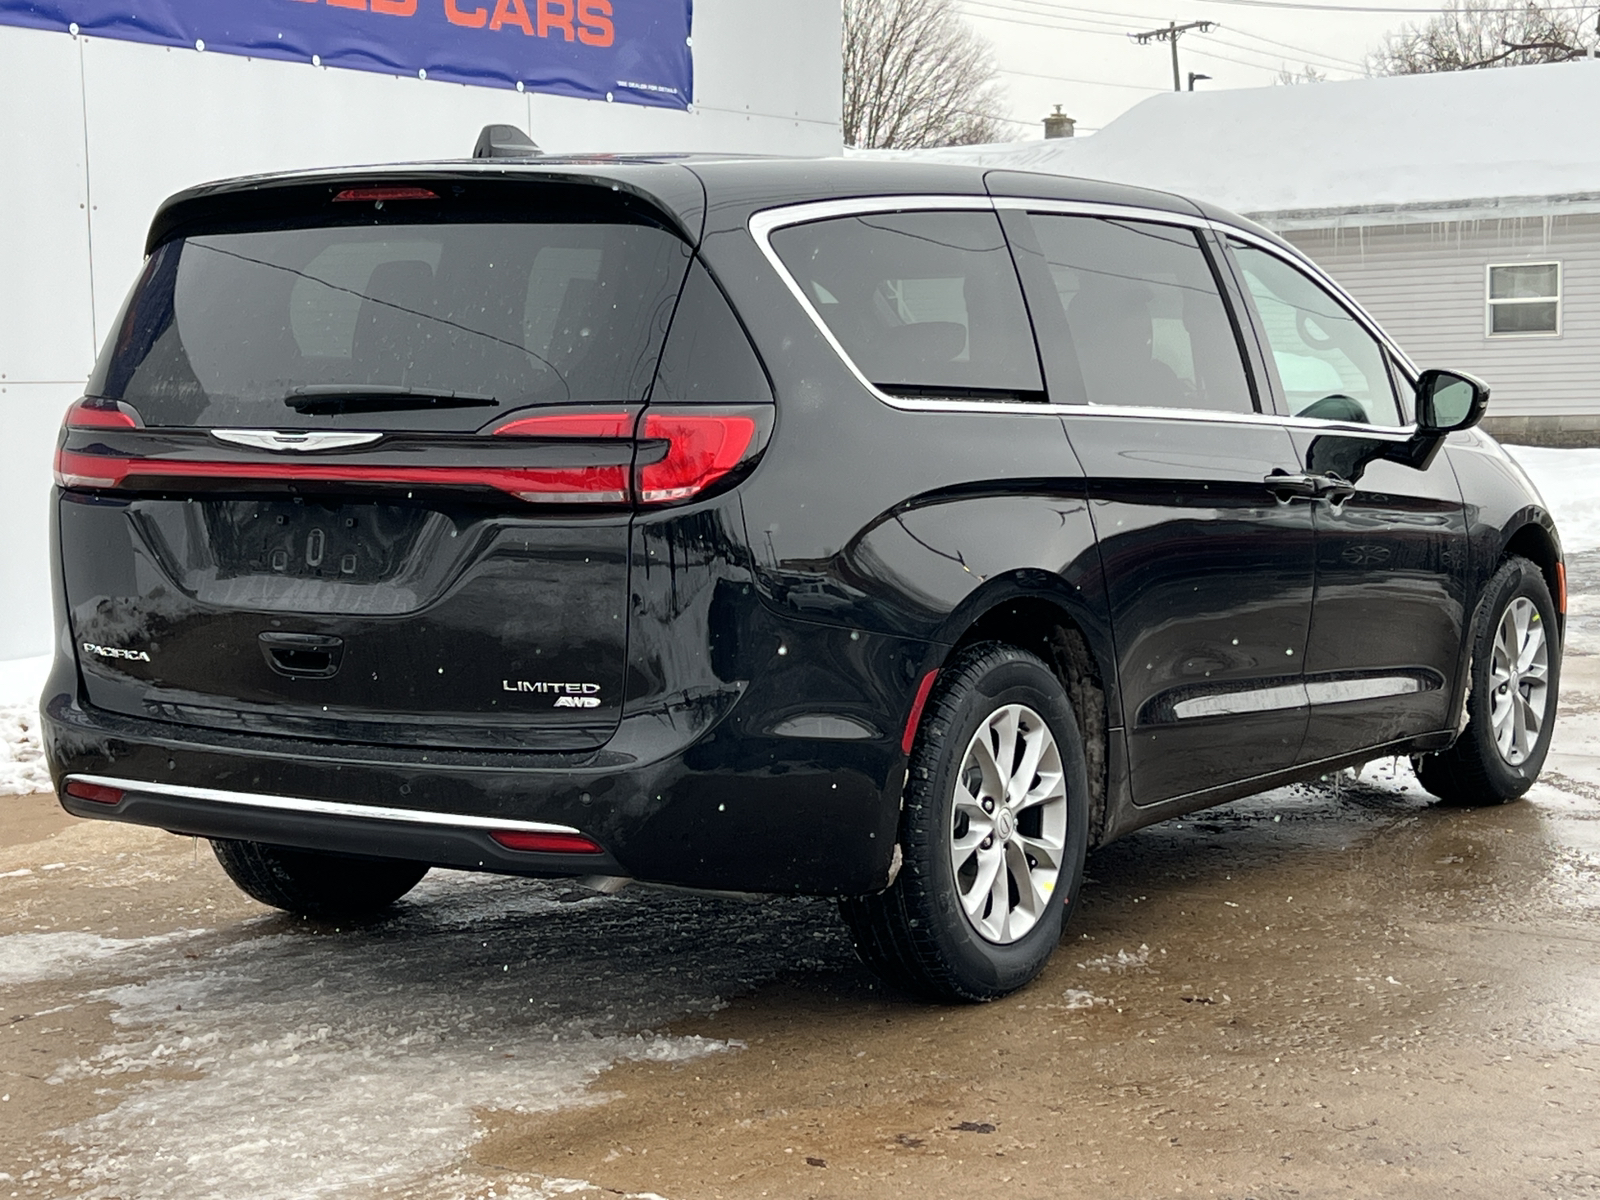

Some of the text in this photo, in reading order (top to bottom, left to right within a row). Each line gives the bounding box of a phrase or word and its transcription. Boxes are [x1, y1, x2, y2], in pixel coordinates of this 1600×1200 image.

[444, 0, 614, 47] CARS
[83, 642, 151, 662] PACIFICA
[502, 680, 601, 694] LIMITED
[553, 696, 601, 708] AWD
